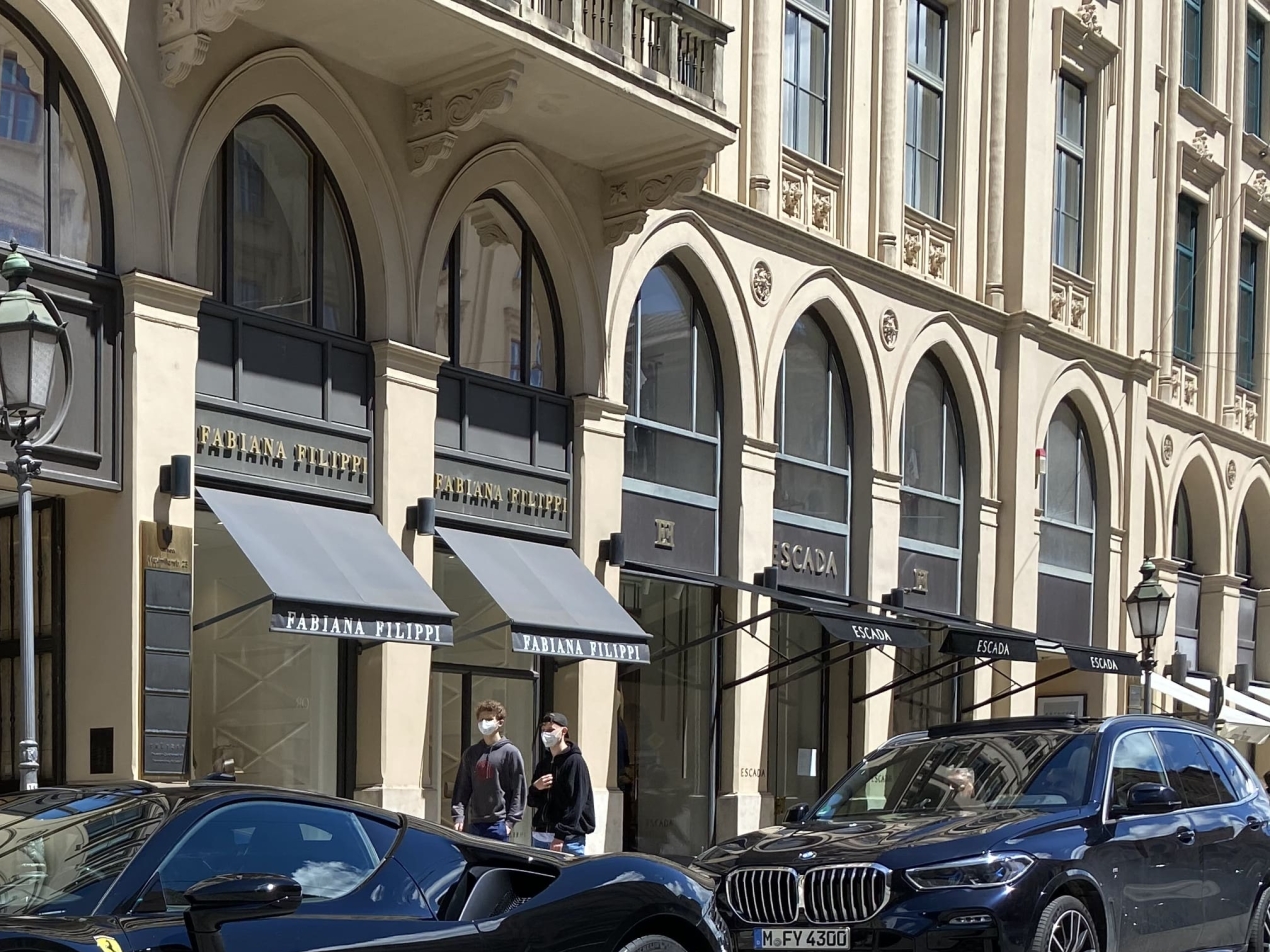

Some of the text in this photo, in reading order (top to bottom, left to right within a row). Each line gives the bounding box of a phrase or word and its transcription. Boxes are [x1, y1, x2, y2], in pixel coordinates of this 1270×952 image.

[200, 424, 368, 475] FABIANA FILIPPI
[435, 472, 568, 513] FABIANA FILIPPI
[286, 611, 441, 642] FABIANA FILIPPI
[851, 624, 893, 642] ESCADA
[522, 634, 640, 660] FABIANA FILIPPI
[976, 639, 1010, 656] ESCADA
[1089, 656, 1119, 671] ESCADA
[740, 768, 766, 778] ESCADA
[806, 930, 847, 947] 4300
